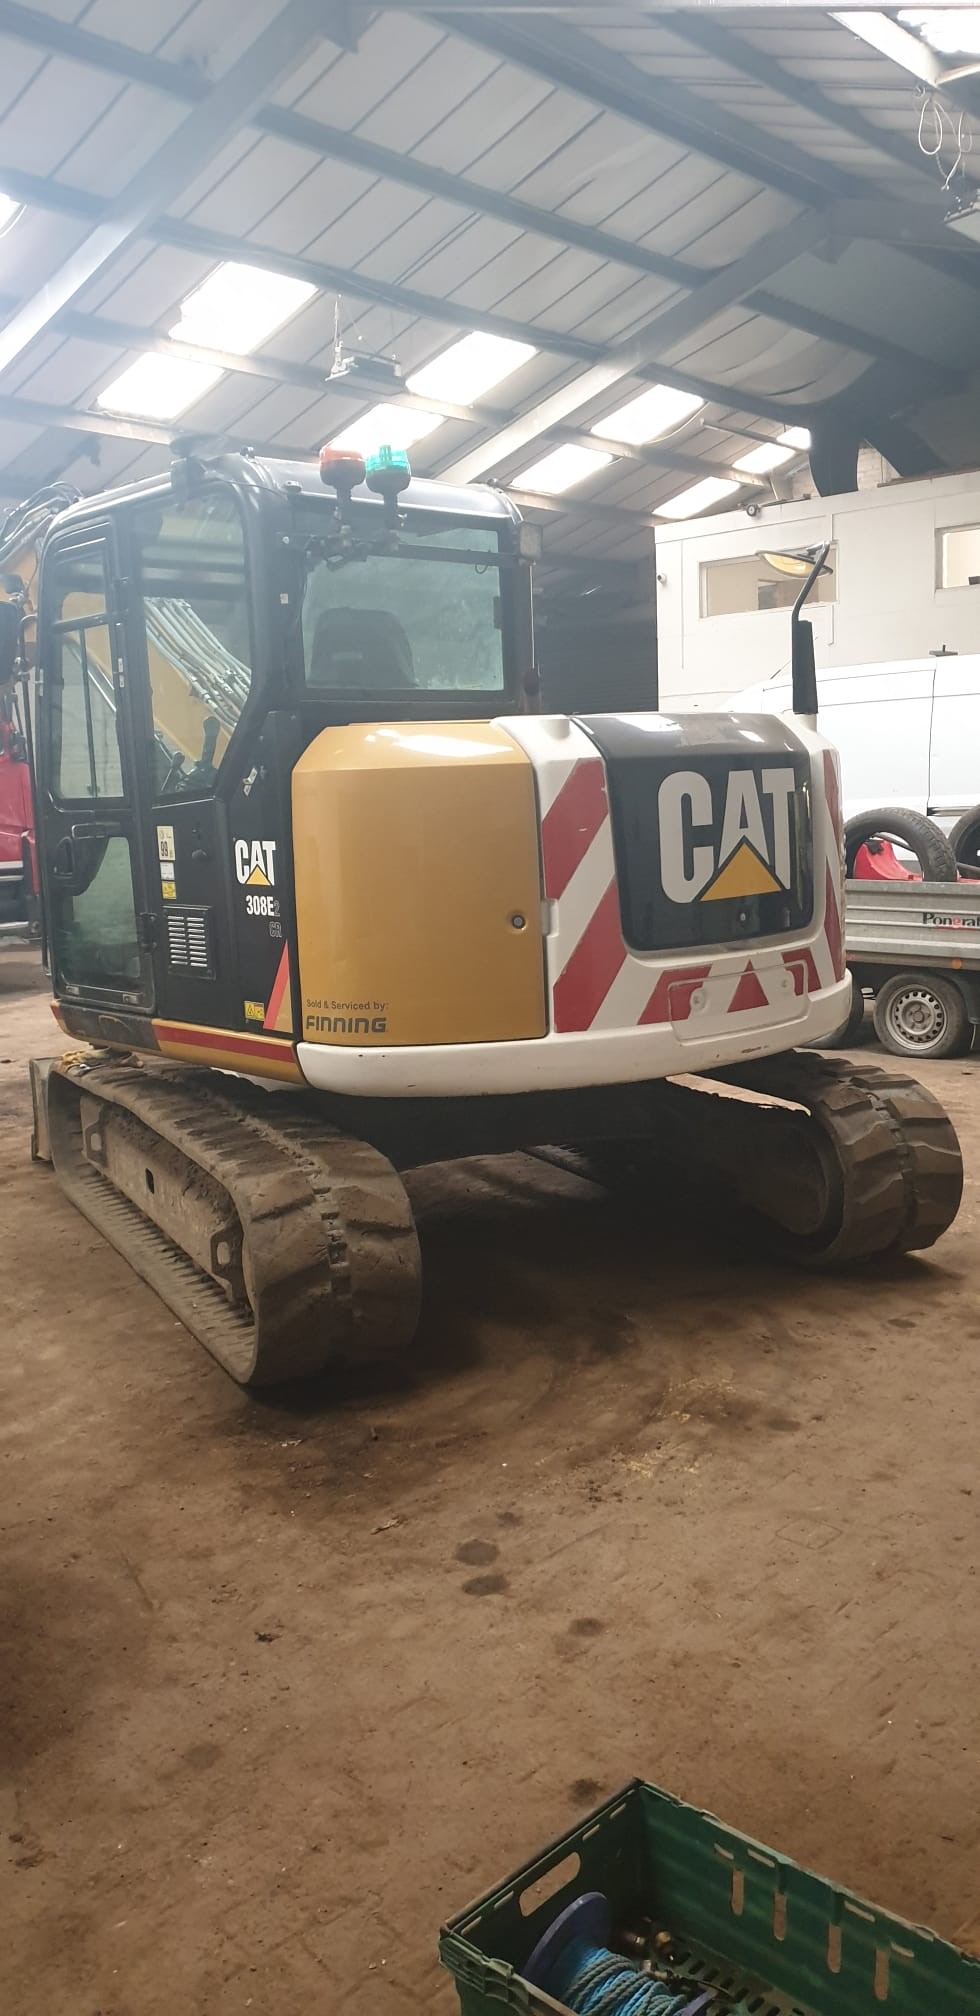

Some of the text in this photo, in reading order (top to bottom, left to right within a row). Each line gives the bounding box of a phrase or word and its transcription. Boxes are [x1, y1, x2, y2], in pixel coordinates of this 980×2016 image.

[658, 768, 795, 904] CAT
[235, 839, 276, 886] CAT
[246, 894, 281, 917] 308E2
[269, 921, 282, 938] CR
[306, 999, 390, 1012] Sold & Serviced by:
[306, 1015, 387, 1033] FINNING
